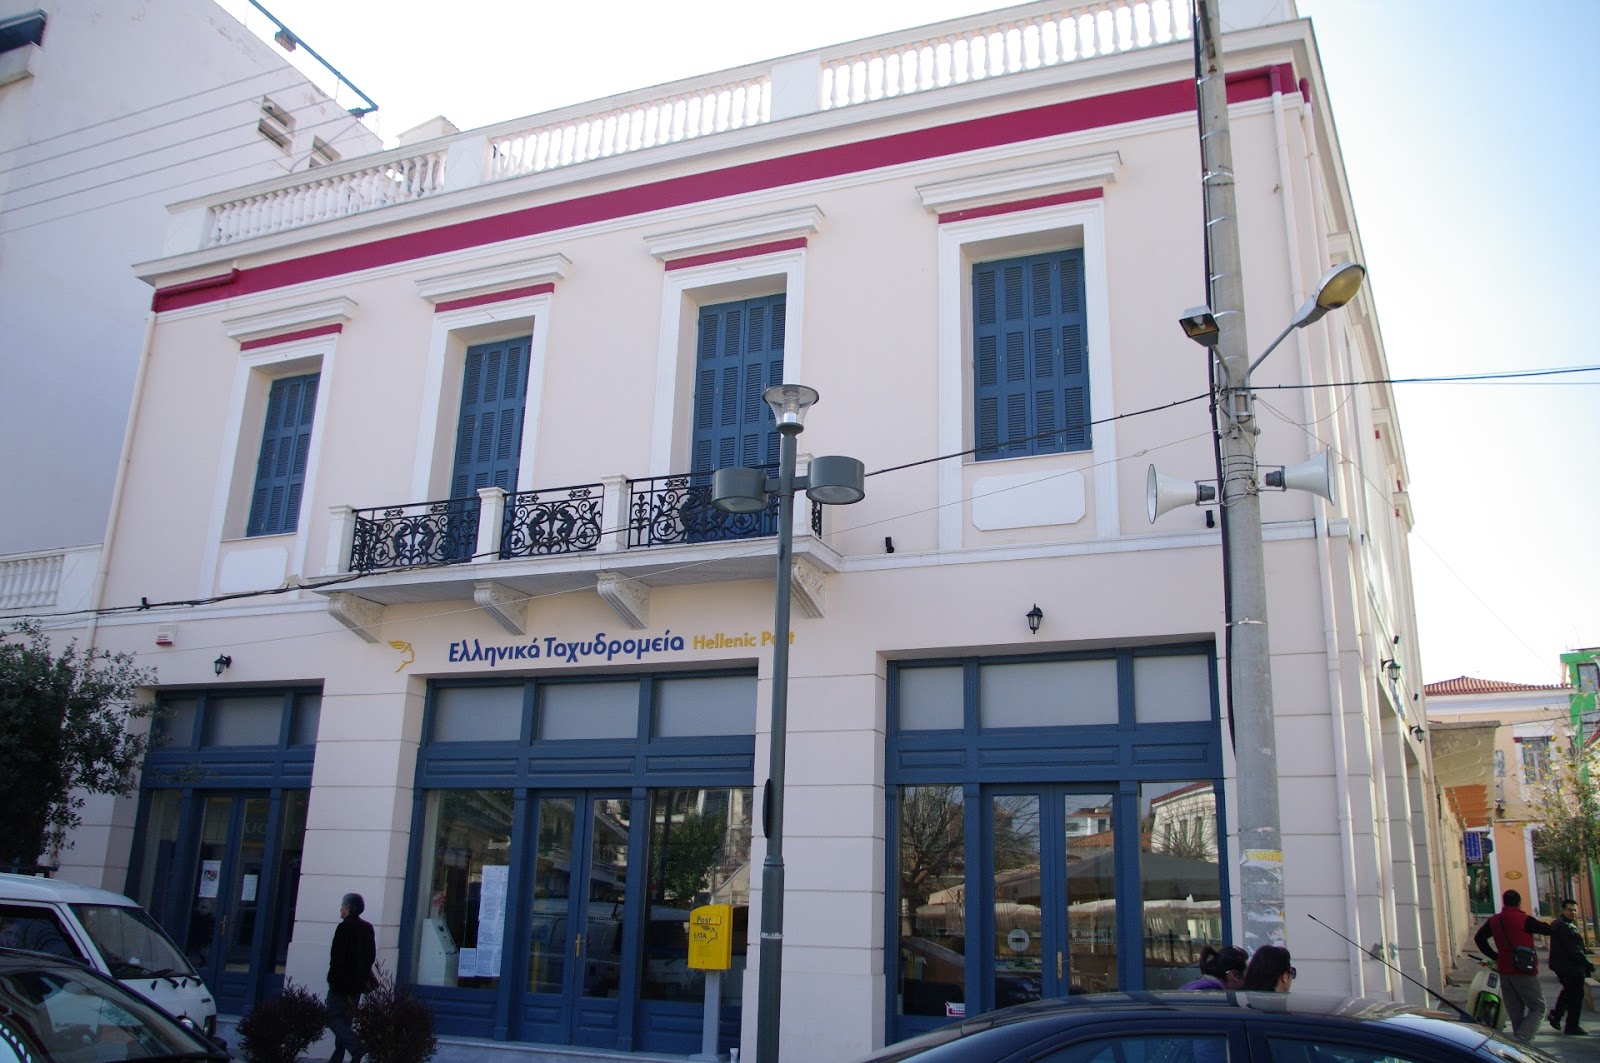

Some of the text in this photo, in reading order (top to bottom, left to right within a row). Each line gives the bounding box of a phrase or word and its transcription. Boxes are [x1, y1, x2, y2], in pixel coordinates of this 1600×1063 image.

[449, 629, 685, 667] Ελληνικά Ταχυδρομεία
[693, 632, 757, 650] Hellenic
